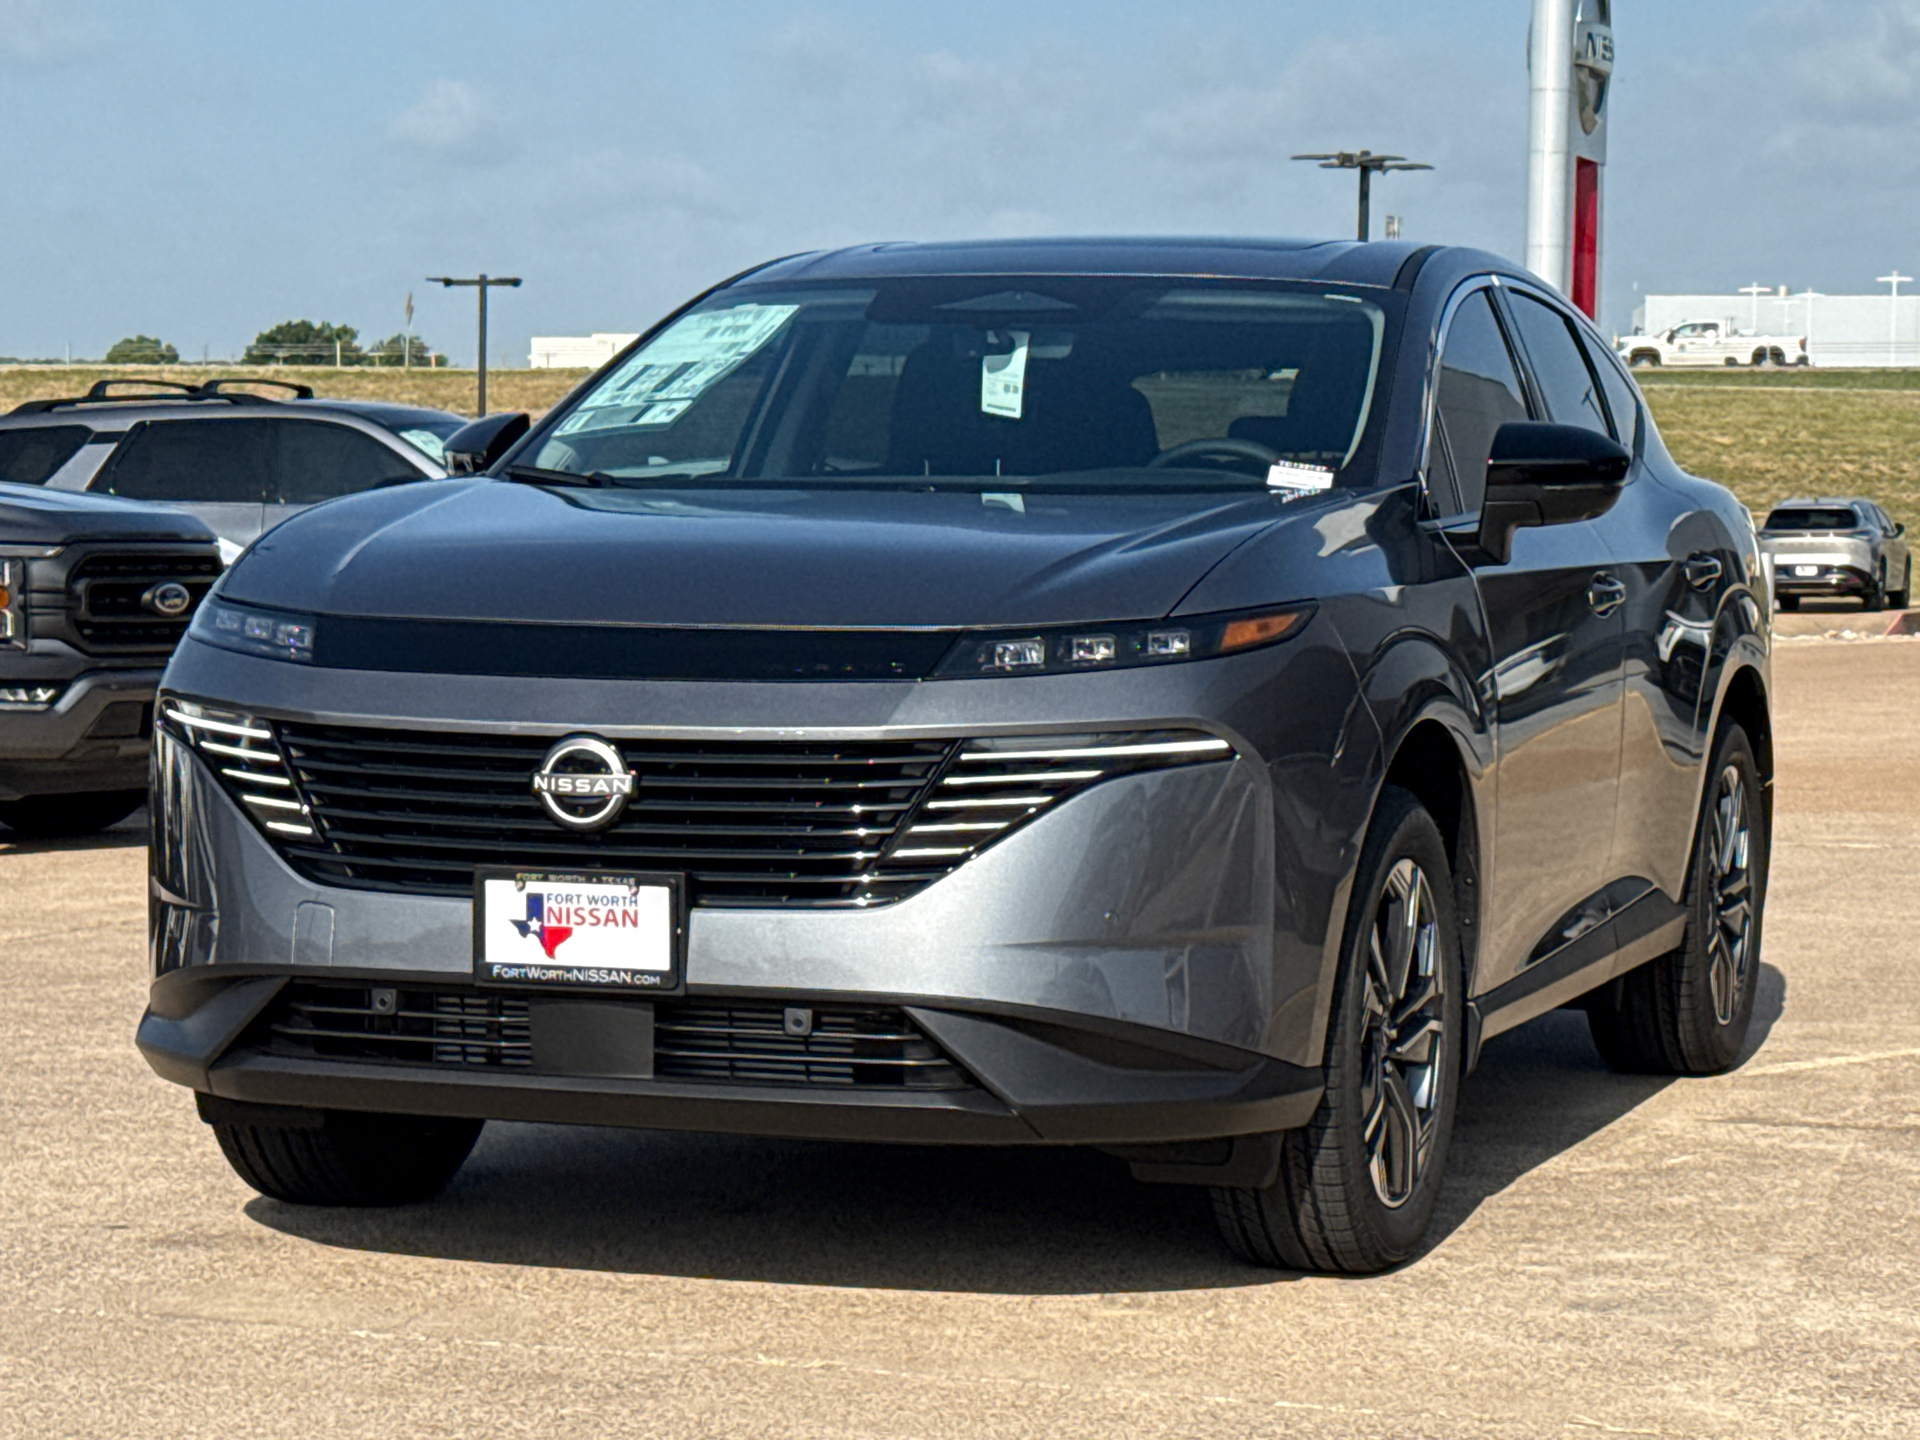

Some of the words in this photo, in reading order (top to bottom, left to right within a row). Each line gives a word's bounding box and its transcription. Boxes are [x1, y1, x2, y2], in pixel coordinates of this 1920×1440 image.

[533, 775, 632, 793] NISSAN
[601, 876, 636, 885] TEXAS
[546, 892, 583, 905] FORT
[586, 894, 638, 908] WORTH
[546, 906, 639, 928] NISSAN
